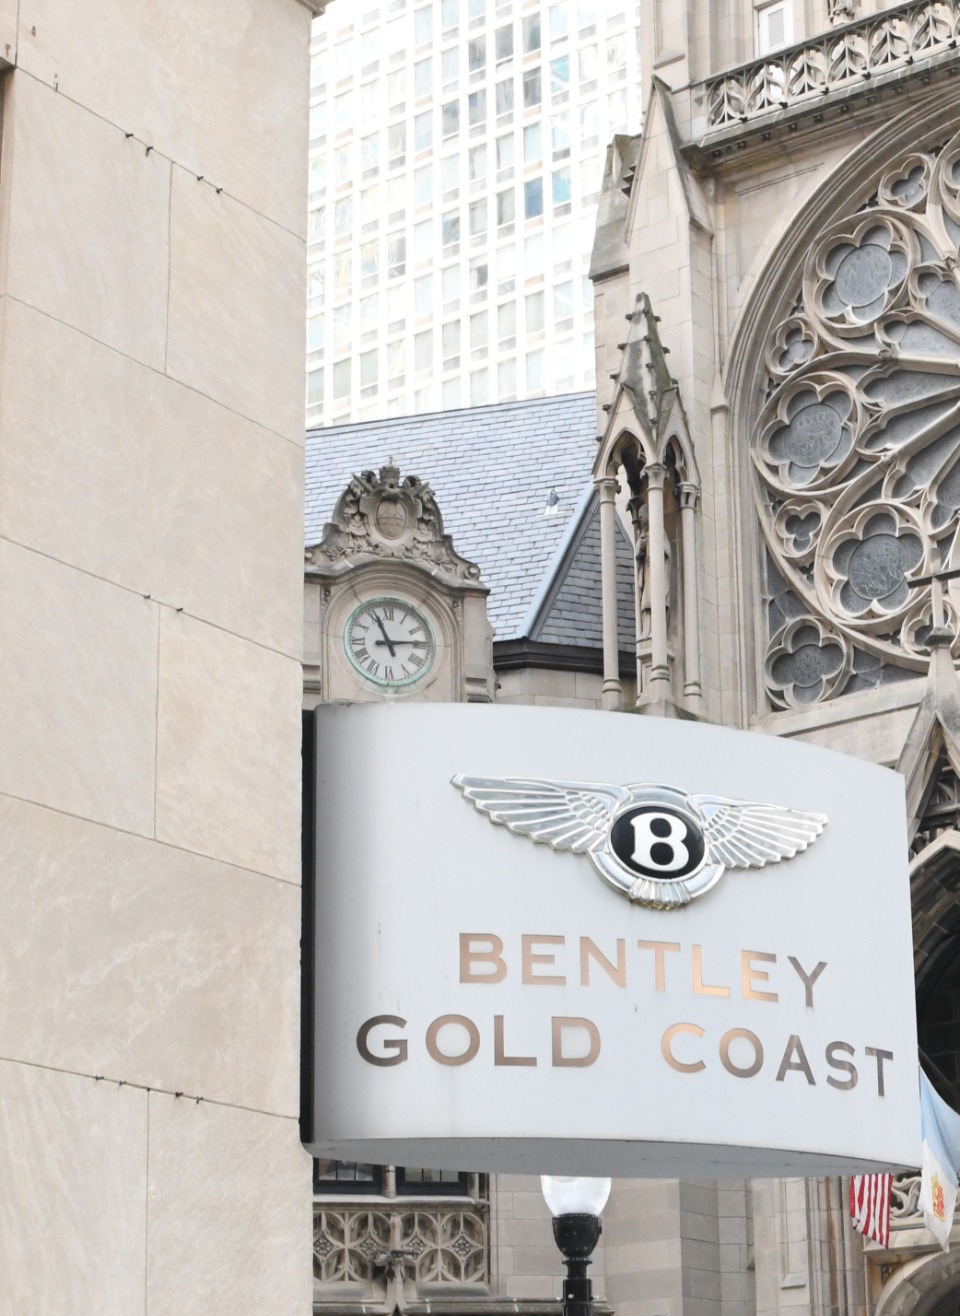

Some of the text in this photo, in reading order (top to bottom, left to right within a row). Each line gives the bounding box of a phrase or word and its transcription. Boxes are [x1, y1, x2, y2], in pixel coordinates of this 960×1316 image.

[630, 812, 689, 872] B
[459, 932, 828, 1009] BENTLEY
[355, 1013, 895, 1098] GOLD COAST
